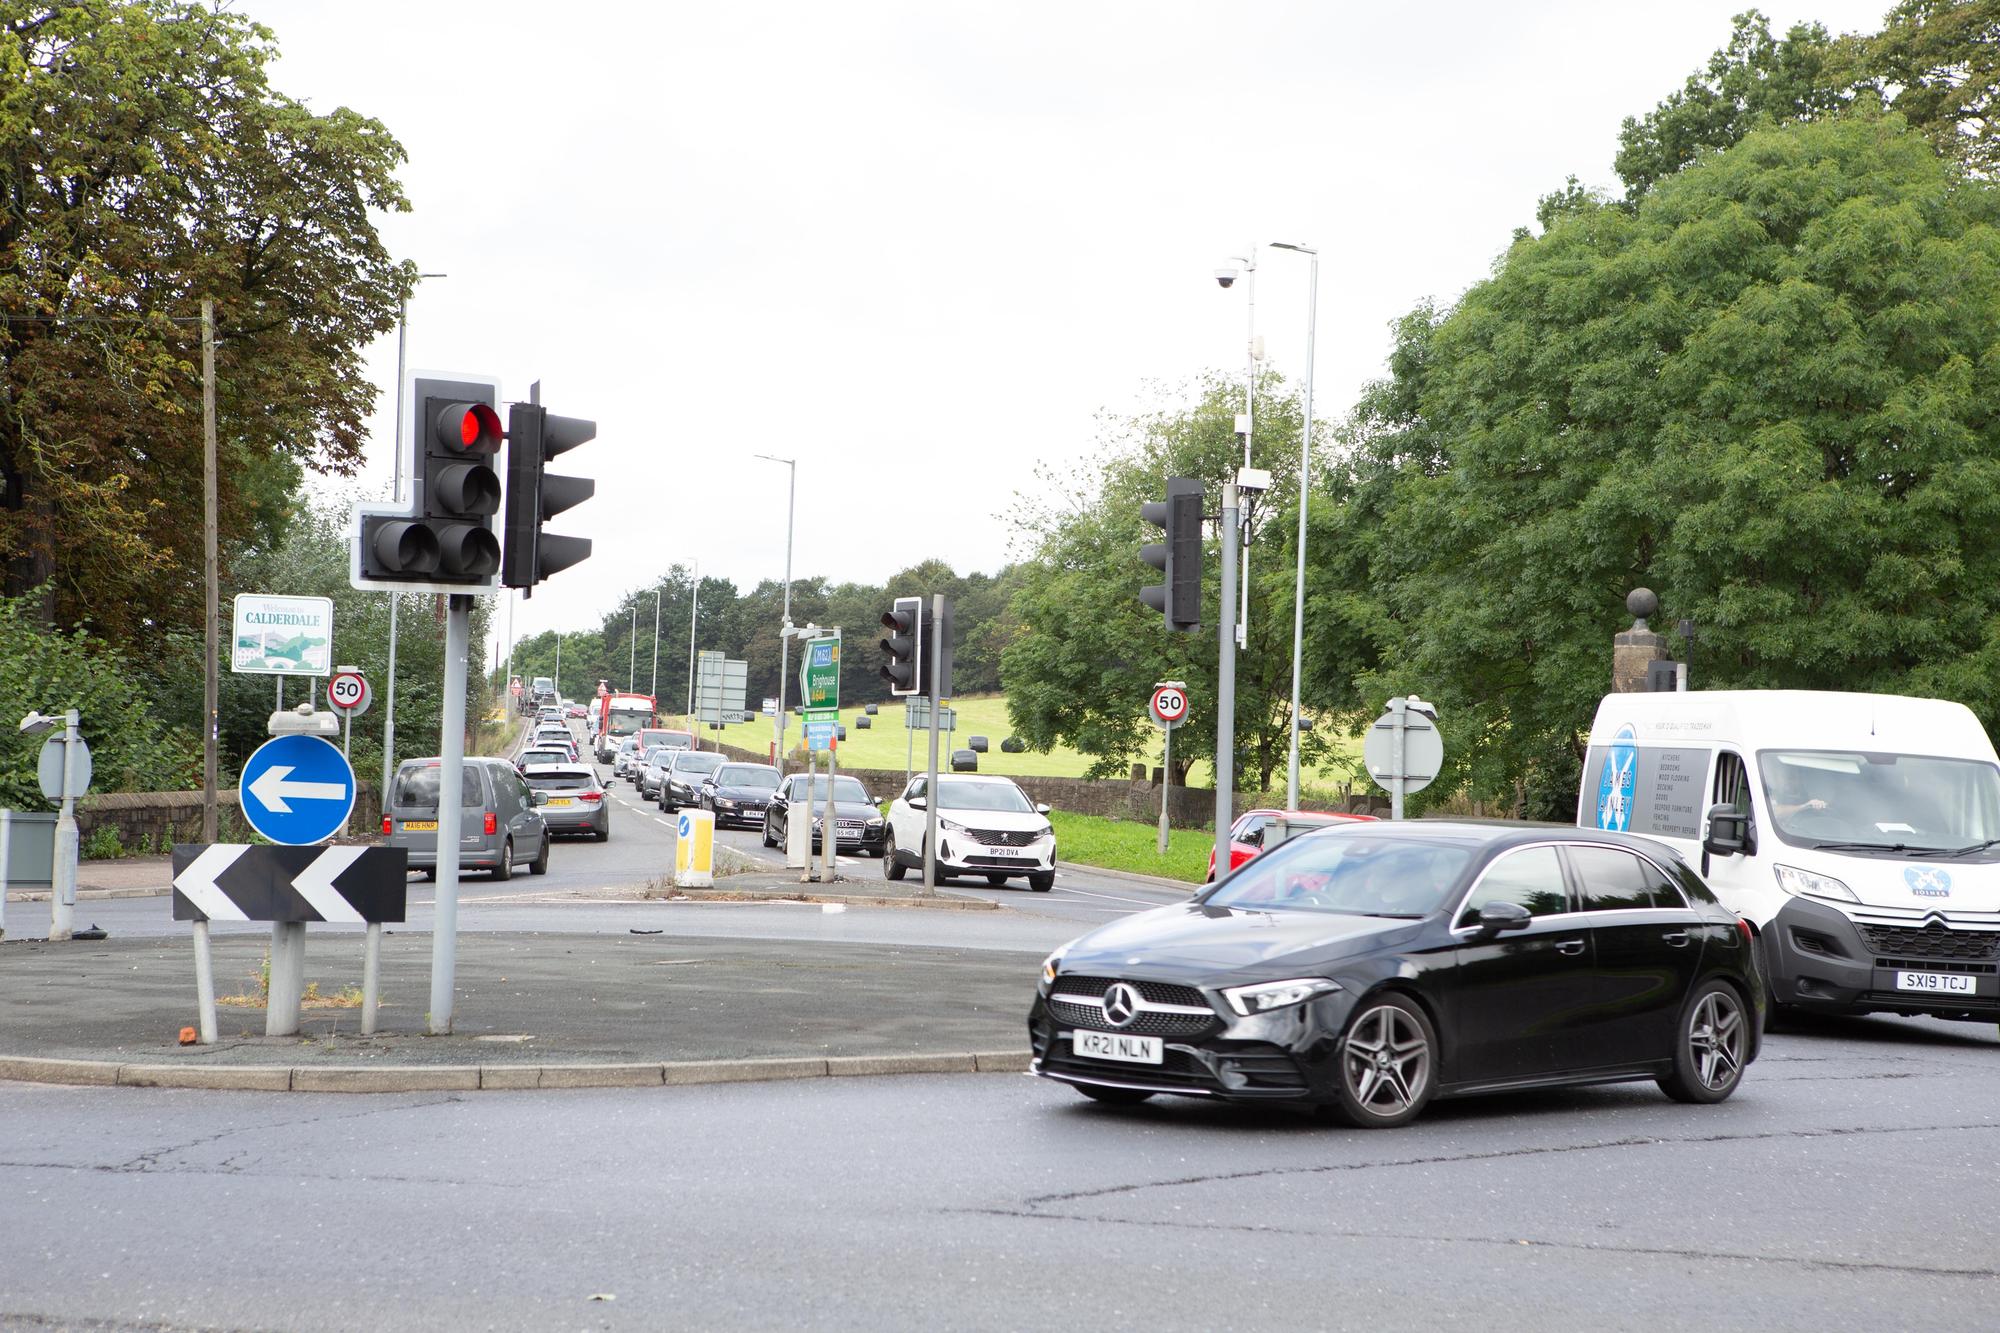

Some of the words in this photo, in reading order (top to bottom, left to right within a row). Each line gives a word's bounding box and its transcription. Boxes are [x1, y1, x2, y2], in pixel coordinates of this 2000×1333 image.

[246, 612, 320, 626] CALDERDALE
[812, 674, 836, 688] Brighouse
[336, 682, 358, 696] 50
[1160, 696, 1181, 710] 50
[990, 848, 1005, 856] BP21
[1907, 974, 1937, 988] SX19
[1942, 976, 1968, 990] TCJ
[1083, 1034, 1114, 1054] KR21
[1118, 1038, 1150, 1058] NLN
